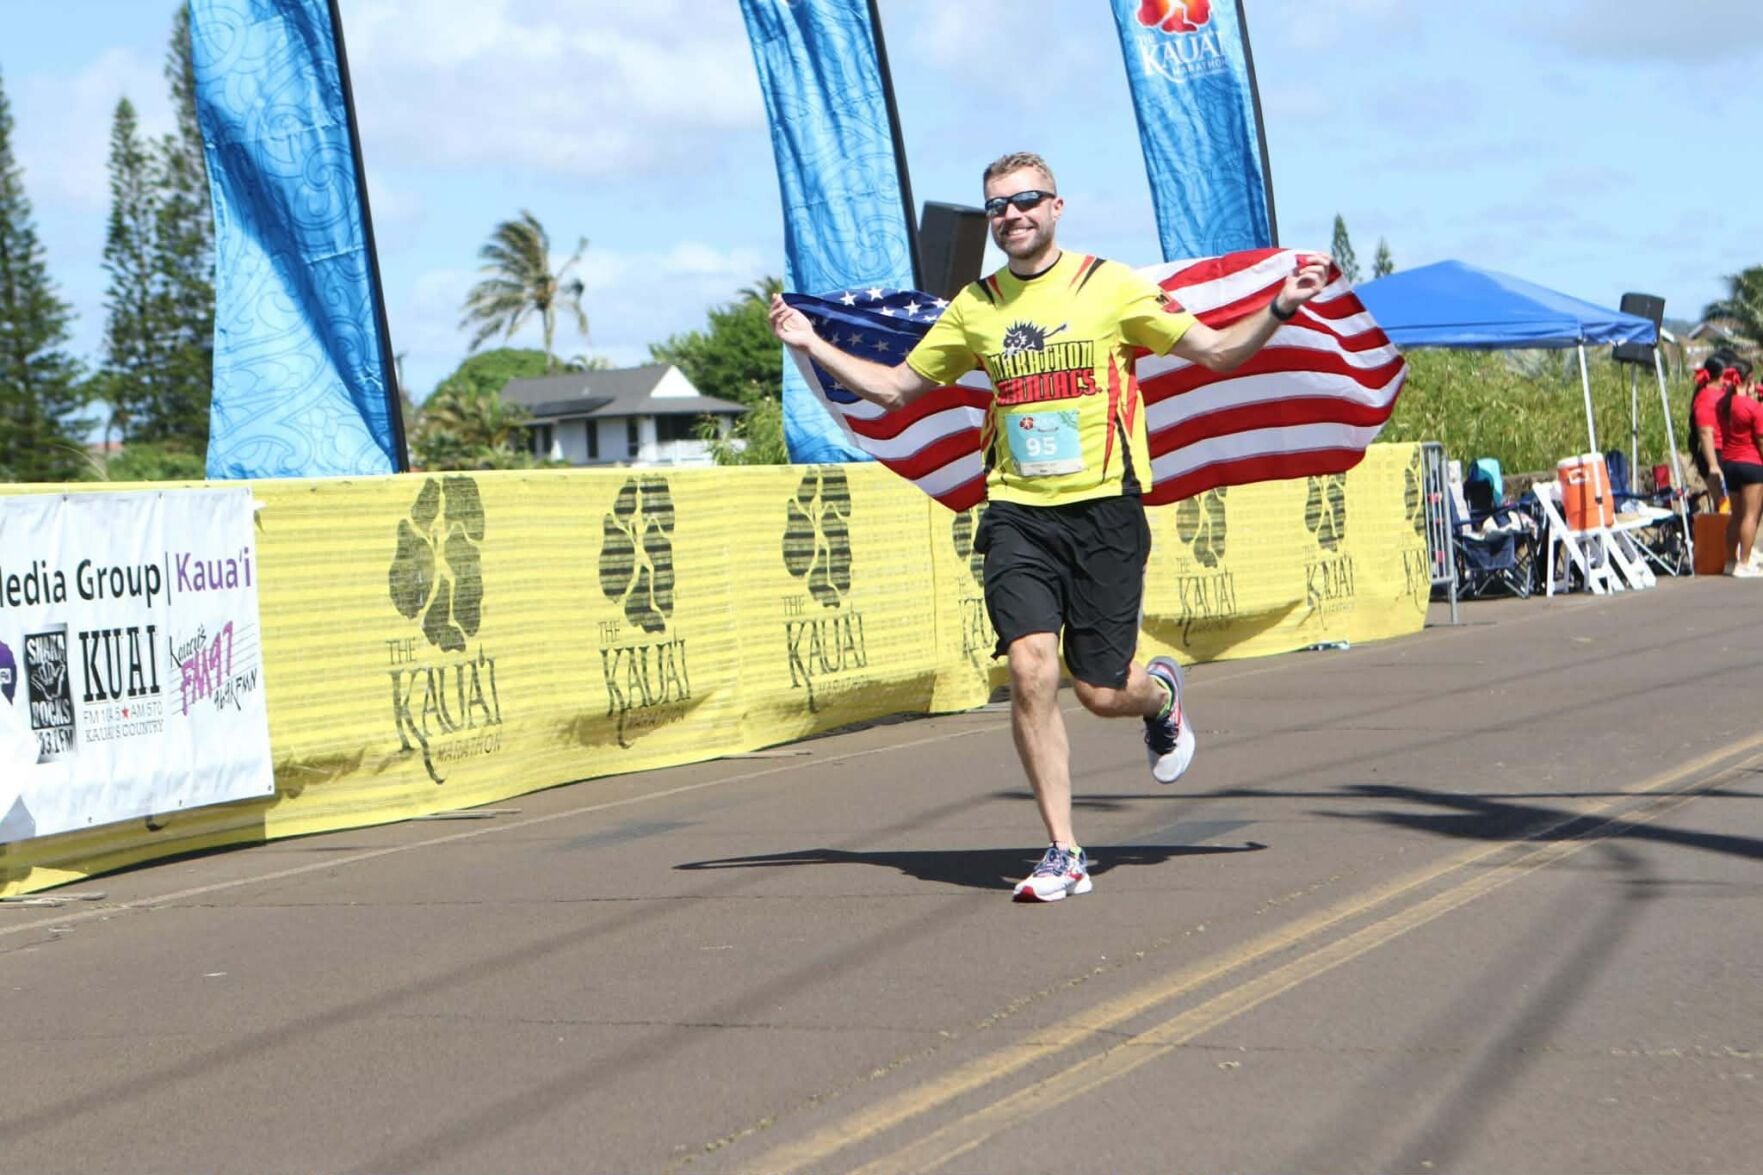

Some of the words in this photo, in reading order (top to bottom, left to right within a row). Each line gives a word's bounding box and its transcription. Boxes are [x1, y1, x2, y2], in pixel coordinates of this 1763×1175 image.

[1025, 437, 1058, 457] 95
[0, 560, 67, 608] edia
[76, 558, 162, 609] Group
[598, 619, 621, 643] THE
[79, 625, 160, 702] KUAI
[385, 637, 417, 665] THE
[122, 719, 163, 737] COUNTRY
